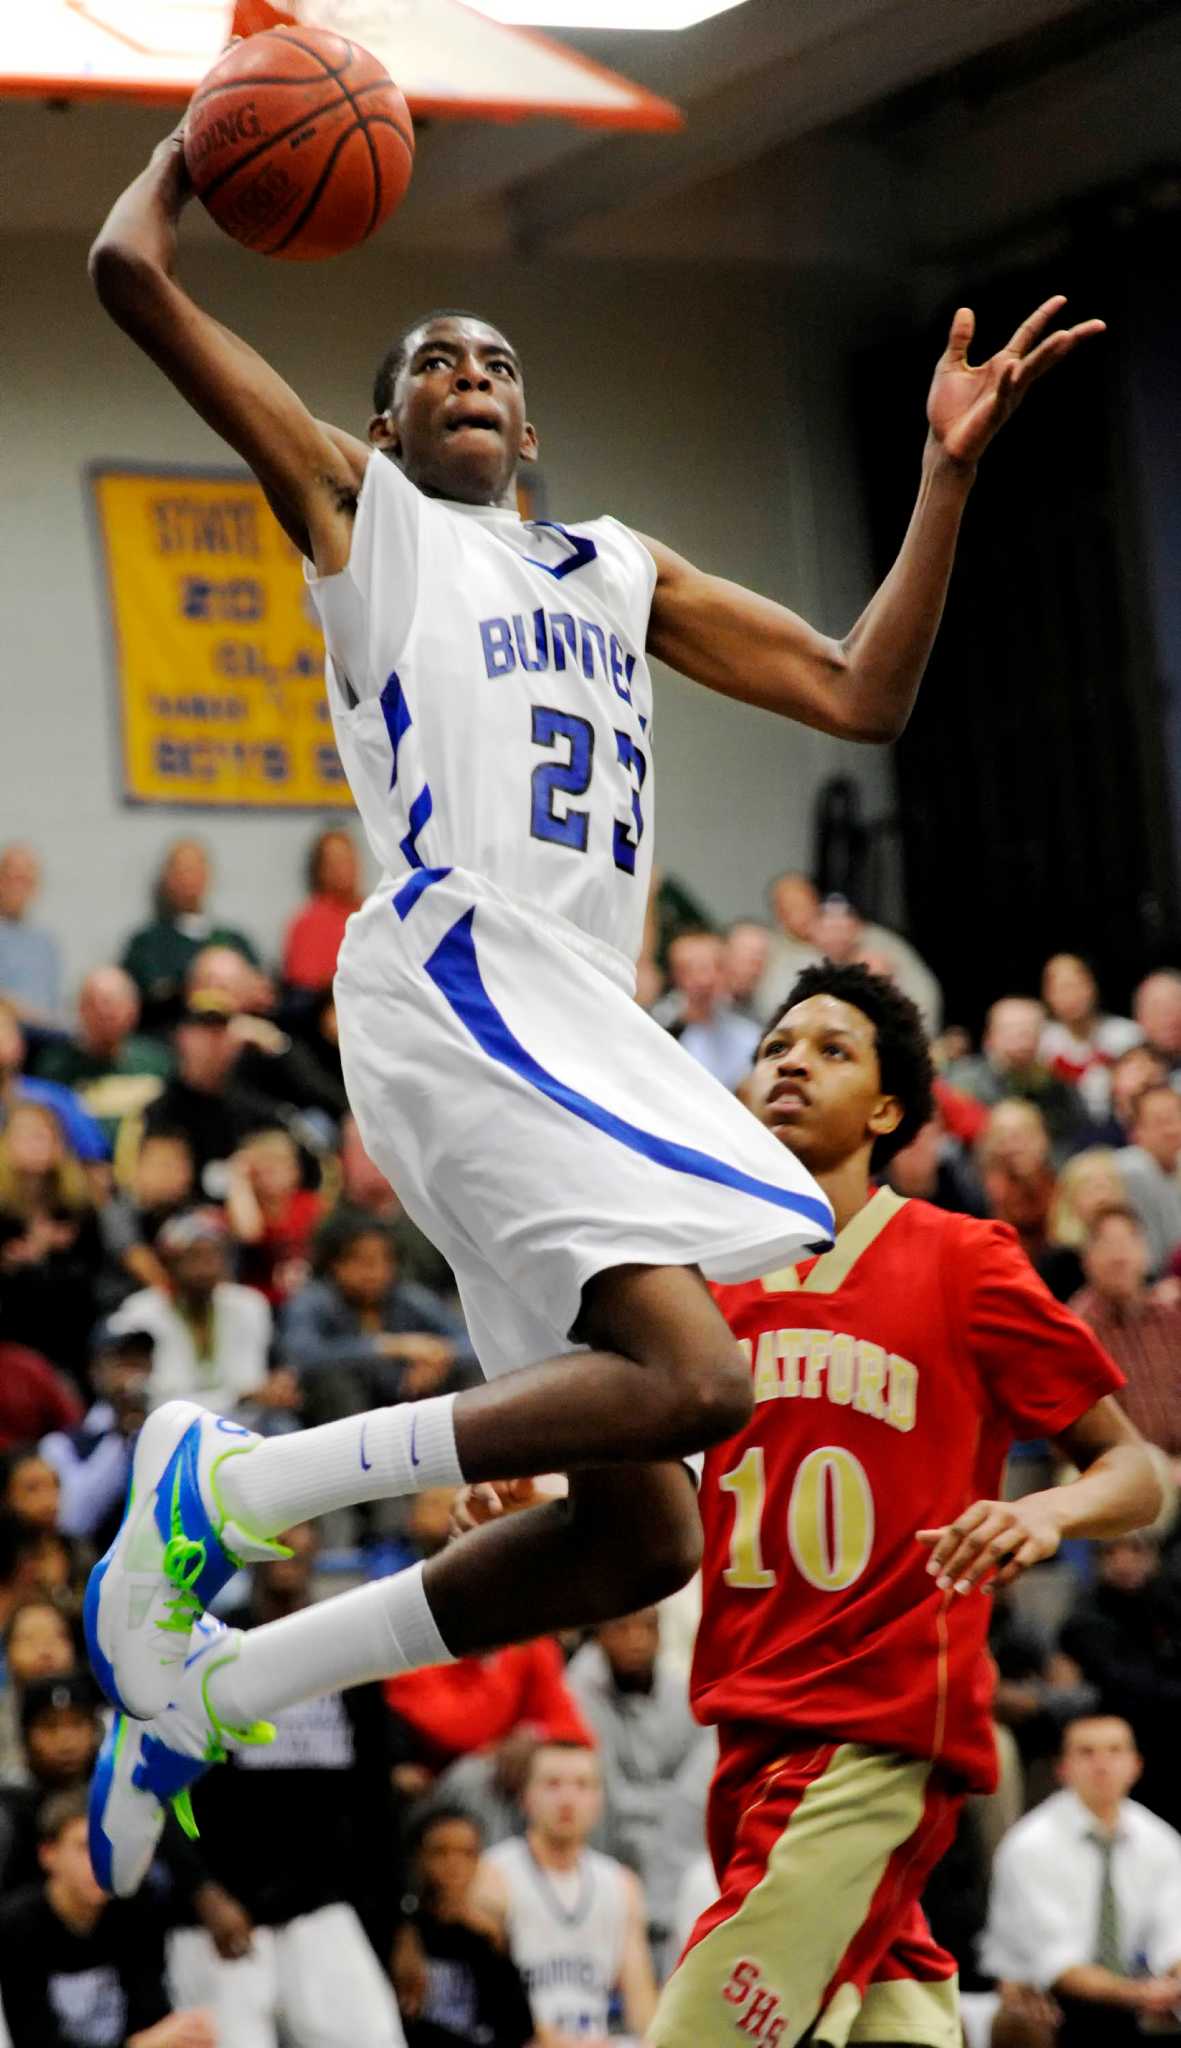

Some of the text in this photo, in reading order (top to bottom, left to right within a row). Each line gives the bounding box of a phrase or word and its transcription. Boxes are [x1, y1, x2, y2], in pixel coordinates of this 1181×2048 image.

[190, 102, 264, 160] DING
[530, 703, 646, 877] 23
[737, 1328, 918, 1432] ATFORD
[719, 1445, 875, 1592] 10
